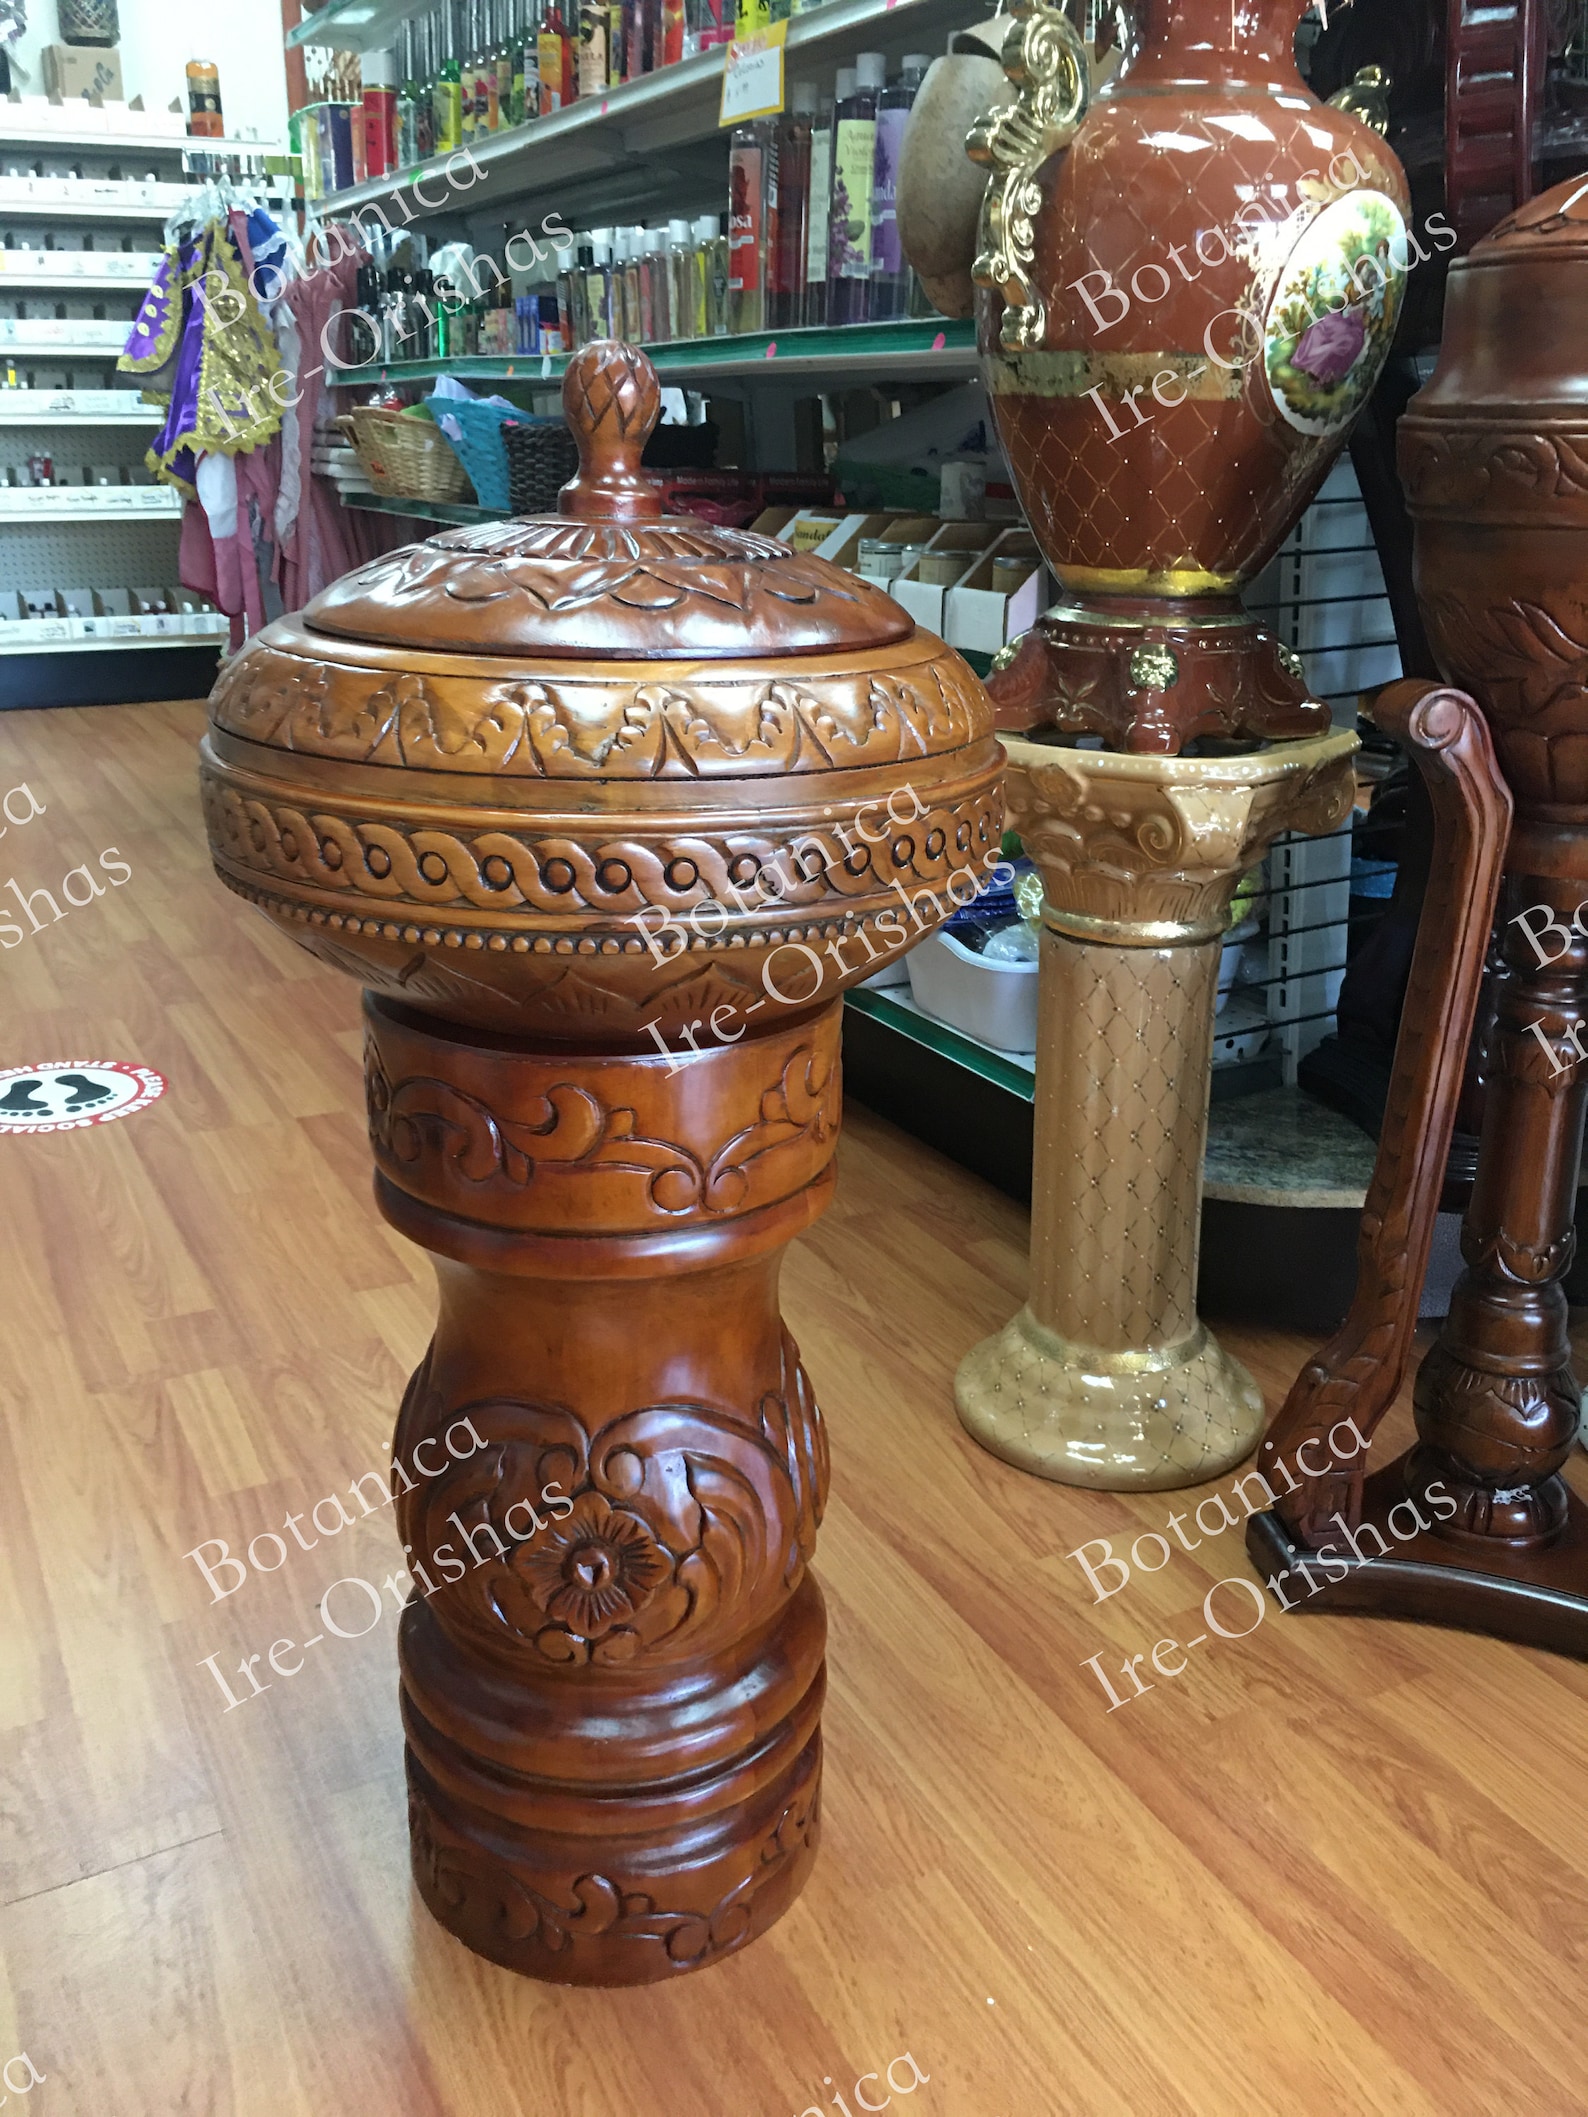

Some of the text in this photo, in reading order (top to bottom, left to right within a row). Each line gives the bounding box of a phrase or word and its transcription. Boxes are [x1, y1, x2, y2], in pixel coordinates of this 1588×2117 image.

[36, 1061, 117, 1070] STAND
[99, 1099, 153, 1122] KEEP
[0, 1119, 93, 1133] SOCIAL
